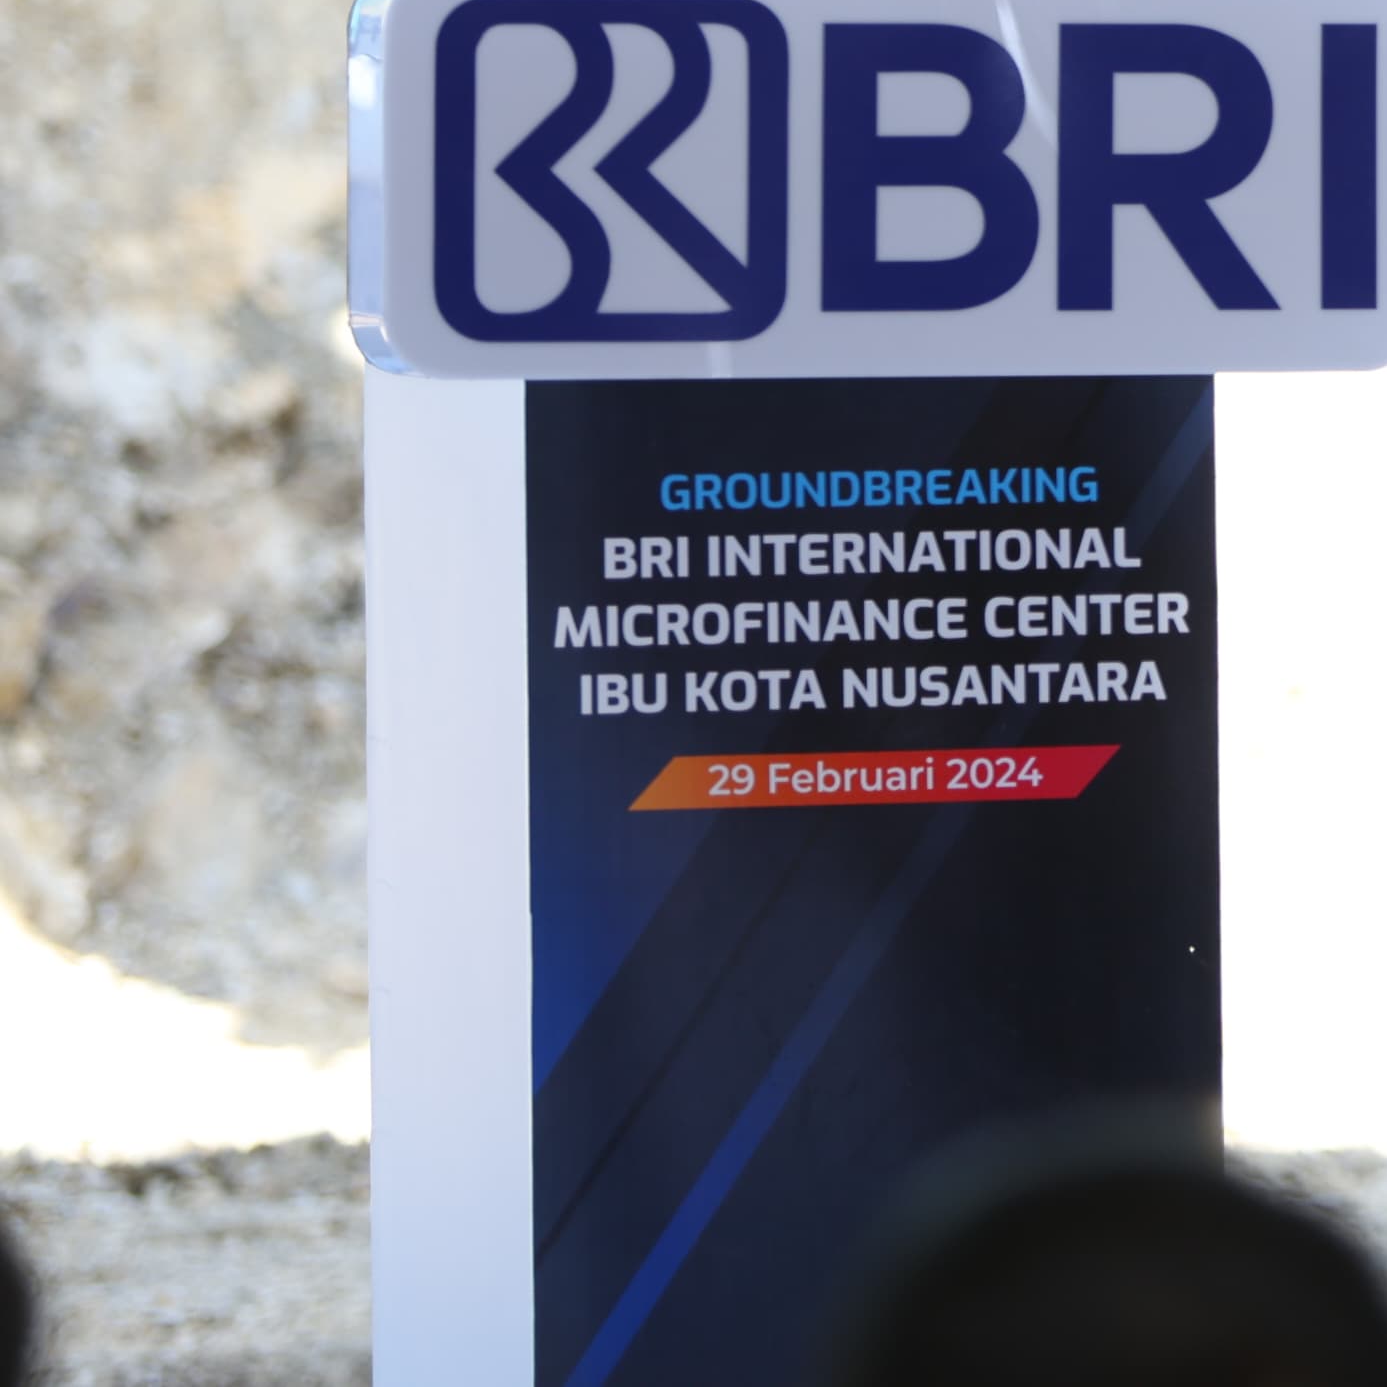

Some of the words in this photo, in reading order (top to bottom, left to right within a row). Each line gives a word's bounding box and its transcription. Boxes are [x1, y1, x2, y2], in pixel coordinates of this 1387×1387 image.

[822, 22, 1378, 312] BRI
[660, 466, 1098, 511] GROUNDBREAKING
[603, 536, 690, 580] BRI
[707, 526, 1142, 577] INTERNATIONAL
[553, 597, 968, 649] MICROFINANCE
[984, 592, 1190, 638] CENTER
[580, 672, 668, 716] IBU
[685, 669, 827, 713] KOTA
[842, 660, 1167, 709] NUSANTARA
[708, 763, 756, 796] 29
[768, 756, 935, 795] Februari
[946, 756, 1045, 790] 2024
